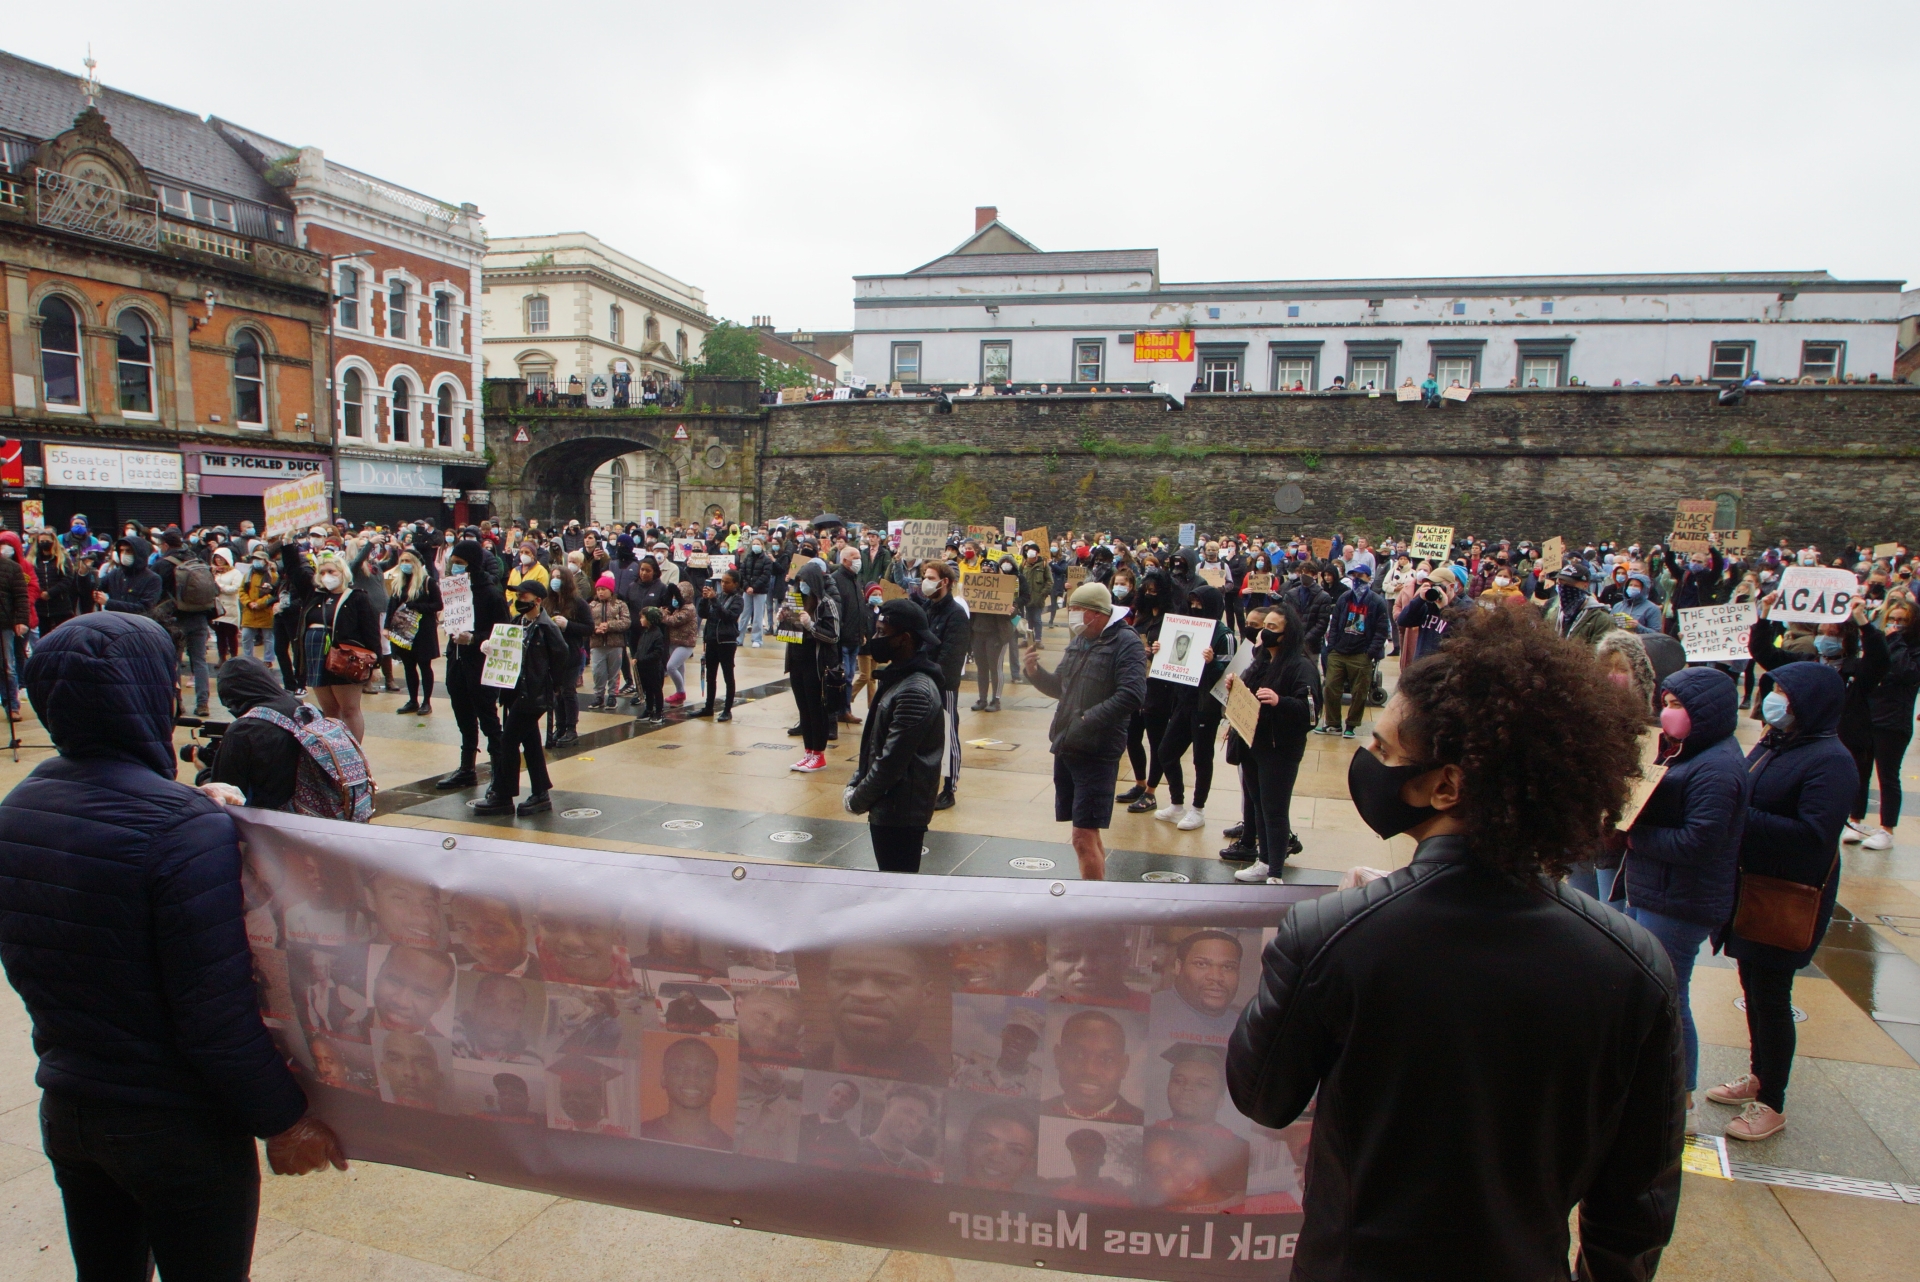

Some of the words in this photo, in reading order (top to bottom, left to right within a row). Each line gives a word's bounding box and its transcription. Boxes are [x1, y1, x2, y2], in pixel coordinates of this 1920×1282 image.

[1136, 333, 1174, 347] Kebab
[1136, 347, 1174, 359] House
[51, 451, 69, 464] 55
[70, 456, 118, 466] seater
[205, 455, 227, 466] THE
[231, 455, 283, 470] PICKLED
[288, 461, 320, 472] DUCK
[62, 468, 110, 482] cafe
[127, 469, 177, 480] garden
[359, 462, 426, 491] Dooley's
[1675, 512, 1712, 523] BLACK
[903, 521, 948, 537] COLOUR
[1417, 526, 1437, 534] BLACK
[1677, 522, 1707, 531] LIVES
[922, 538, 937, 546] NOT
[1672, 531, 1709, 541] MATTER
[1415, 541, 1438, 549] SILENCE
[901, 546, 908, 556] A
[912, 546, 945, 559] CRIME
[964, 574, 1000, 588] RACISM
[444, 597, 454, 606] ARE
[455, 595, 466, 603] THE
[972, 589, 1000, 600] SMALL
[980, 601, 1010, 611] ENERGY
[1773, 588, 1850, 615] ACAB
[1680, 609, 1705, 622] THE
[1711, 605, 1751, 616] COLOUR
[445, 617, 466, 626] EUROPE
[1165, 616, 1190, 625] TRAYVON
[1191, 619, 1212, 628] MARTIN
[1421, 614, 1448, 634] JPN
[1683, 622, 1697, 632] OF
[1706, 614, 1743, 626] THEIR
[1686, 629, 1717, 642] SKIN
[1722, 624, 1751, 636] SHOU
[1686, 641, 1701, 649] NOT
[1701, 644, 1728, 654] THEIR
[486, 657, 518, 672] SYSTEM
[1162, 664, 1190, 674] 1995-2012
[1160, 670, 1171, 678] LIFE
[1172, 673, 1199, 683] MATTERED
